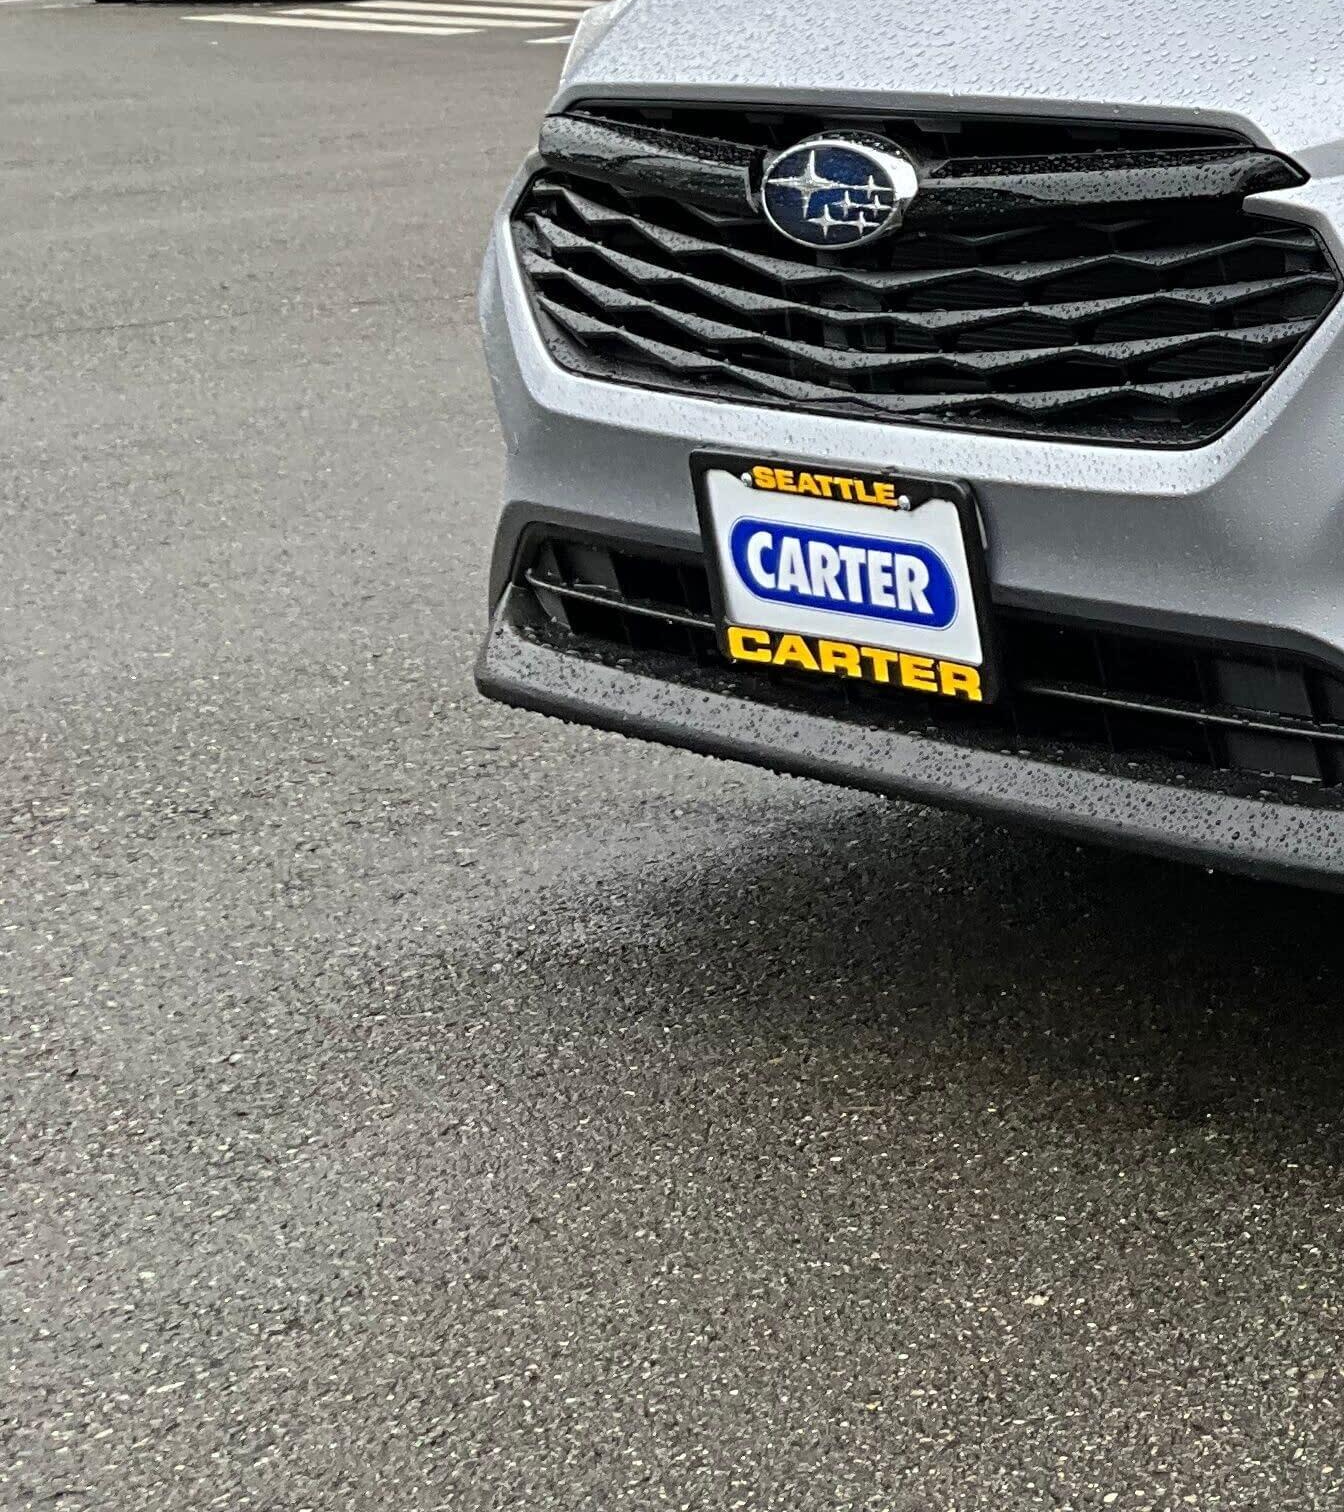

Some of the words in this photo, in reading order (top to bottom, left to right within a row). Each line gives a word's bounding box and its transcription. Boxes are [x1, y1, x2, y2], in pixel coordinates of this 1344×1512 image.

[752, 465, 899, 507] SEATTLE
[747, 530, 934, 615] CARTER
[727, 625, 983, 702] CARTER
